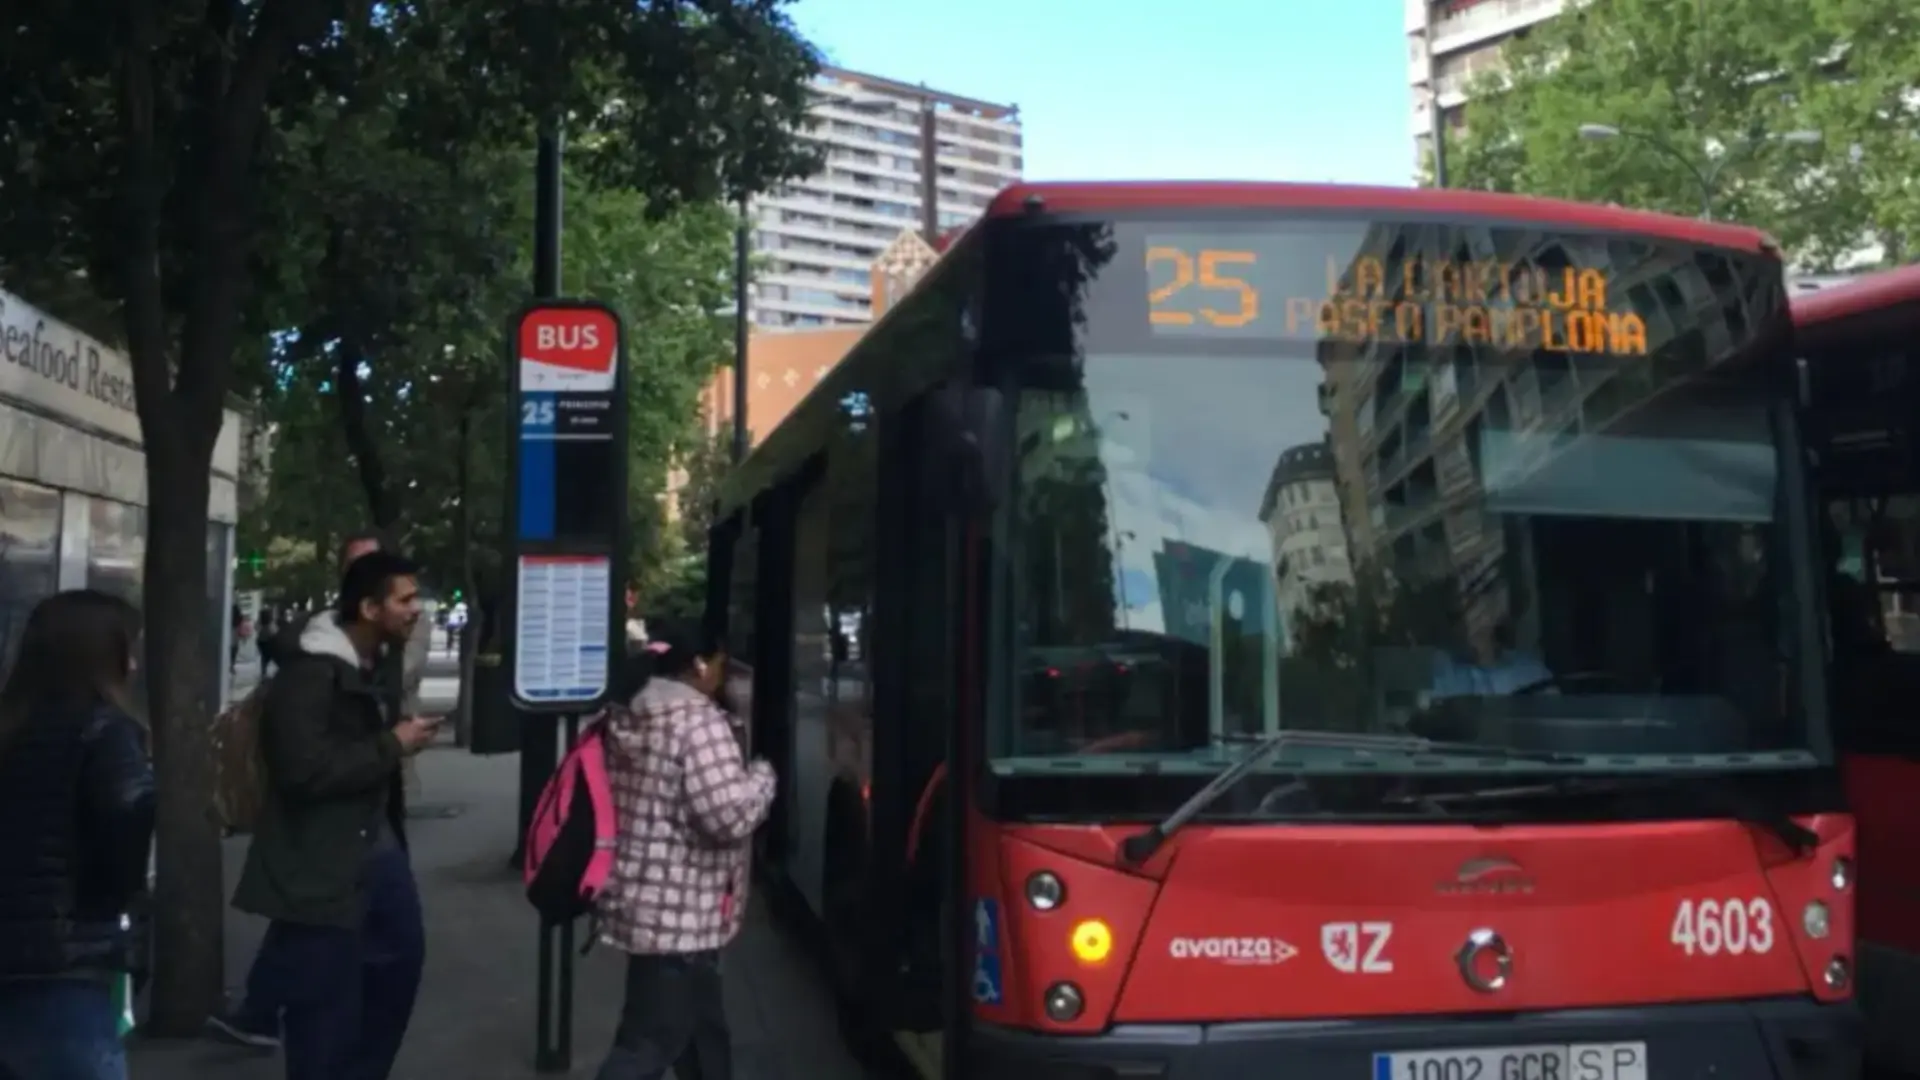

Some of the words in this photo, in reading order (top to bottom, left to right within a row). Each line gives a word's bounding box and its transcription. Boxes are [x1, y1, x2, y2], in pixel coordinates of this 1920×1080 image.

[1146, 246, 1259, 327] 25
[537, 324, 600, 350] BUS
[522, 400, 556, 425] 25
[1671, 898, 1773, 955] 4603
[1170, 937, 1272, 958] avanza
[1407, 1056, 1483, 1080] 1002
[1501, 1052, 1560, 1080] GCR
